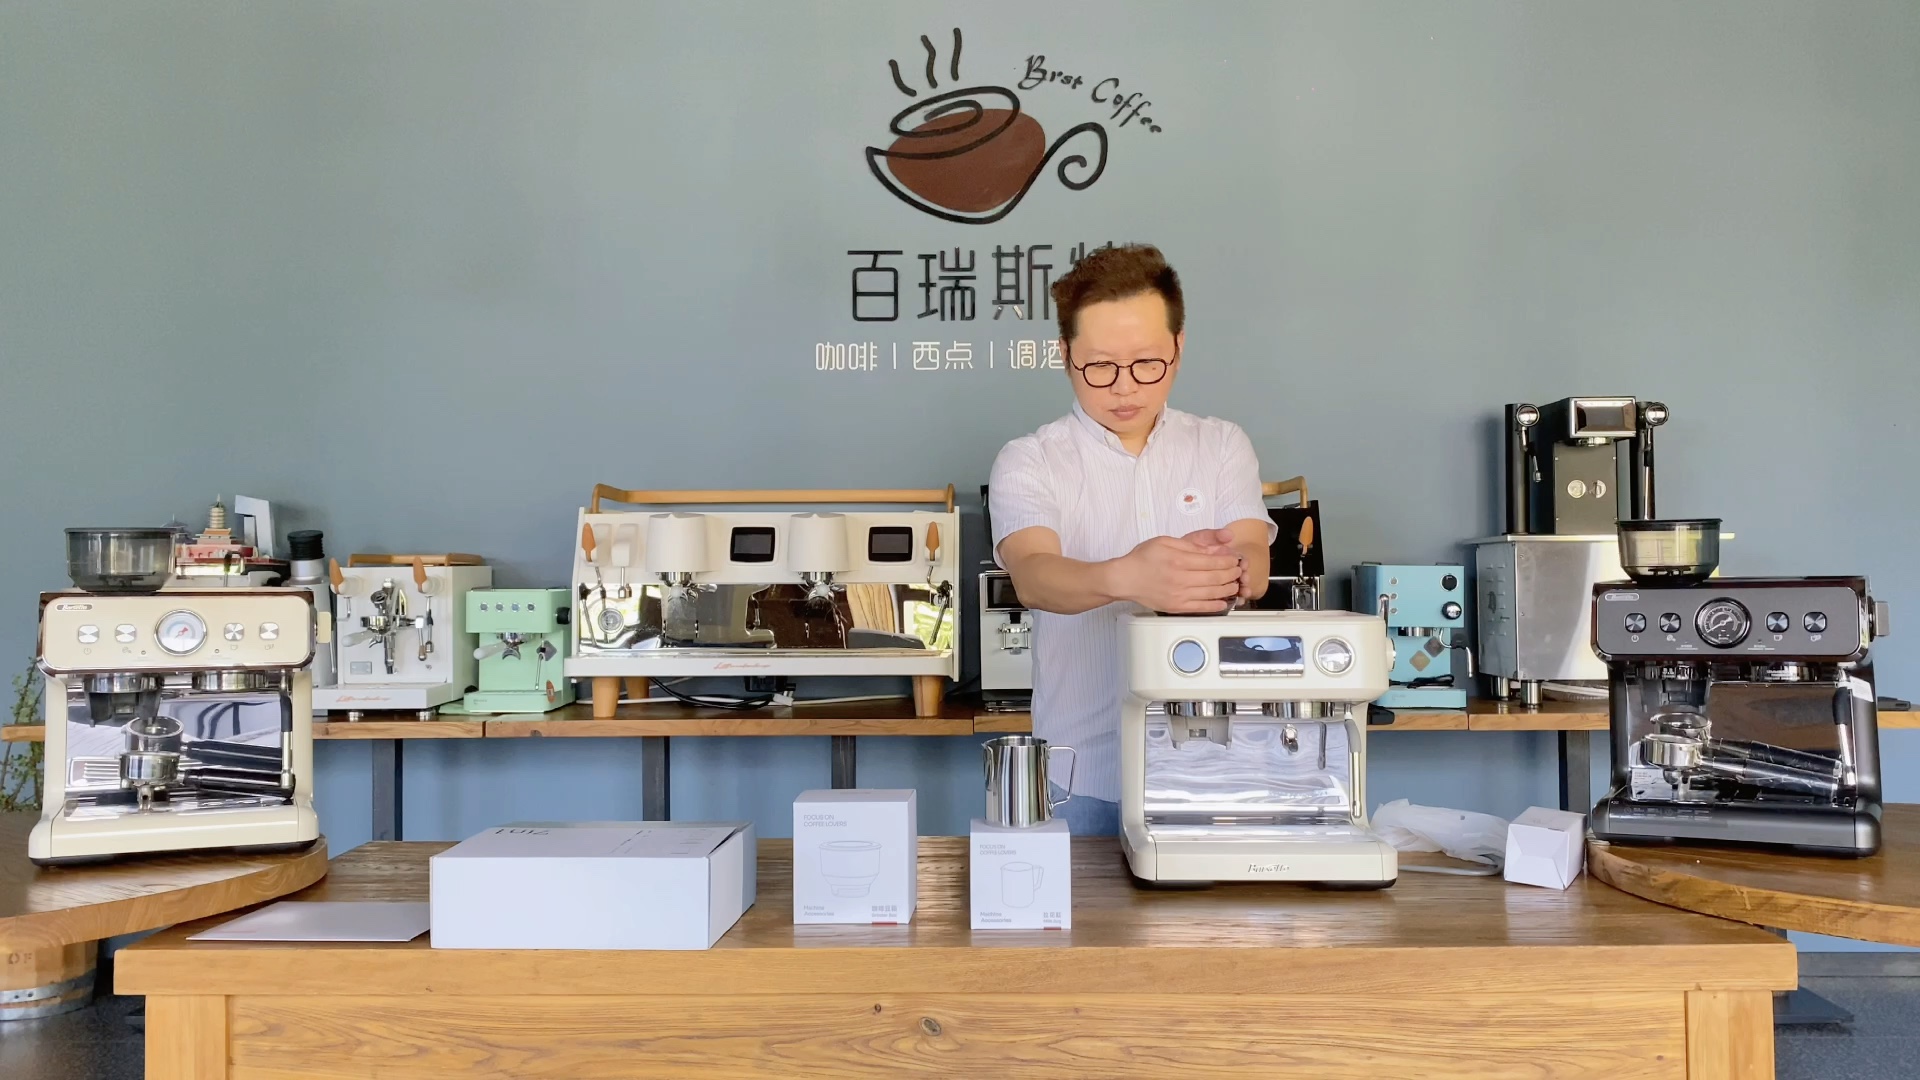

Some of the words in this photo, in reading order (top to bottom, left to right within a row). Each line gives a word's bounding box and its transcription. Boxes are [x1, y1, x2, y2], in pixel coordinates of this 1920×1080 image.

[1091, 77, 1162, 133] Coffee
[847, 241, 1114, 322] 百瑞斯
[815, 341, 878, 371] 咖啡
[912, 340, 974, 371] 西点
